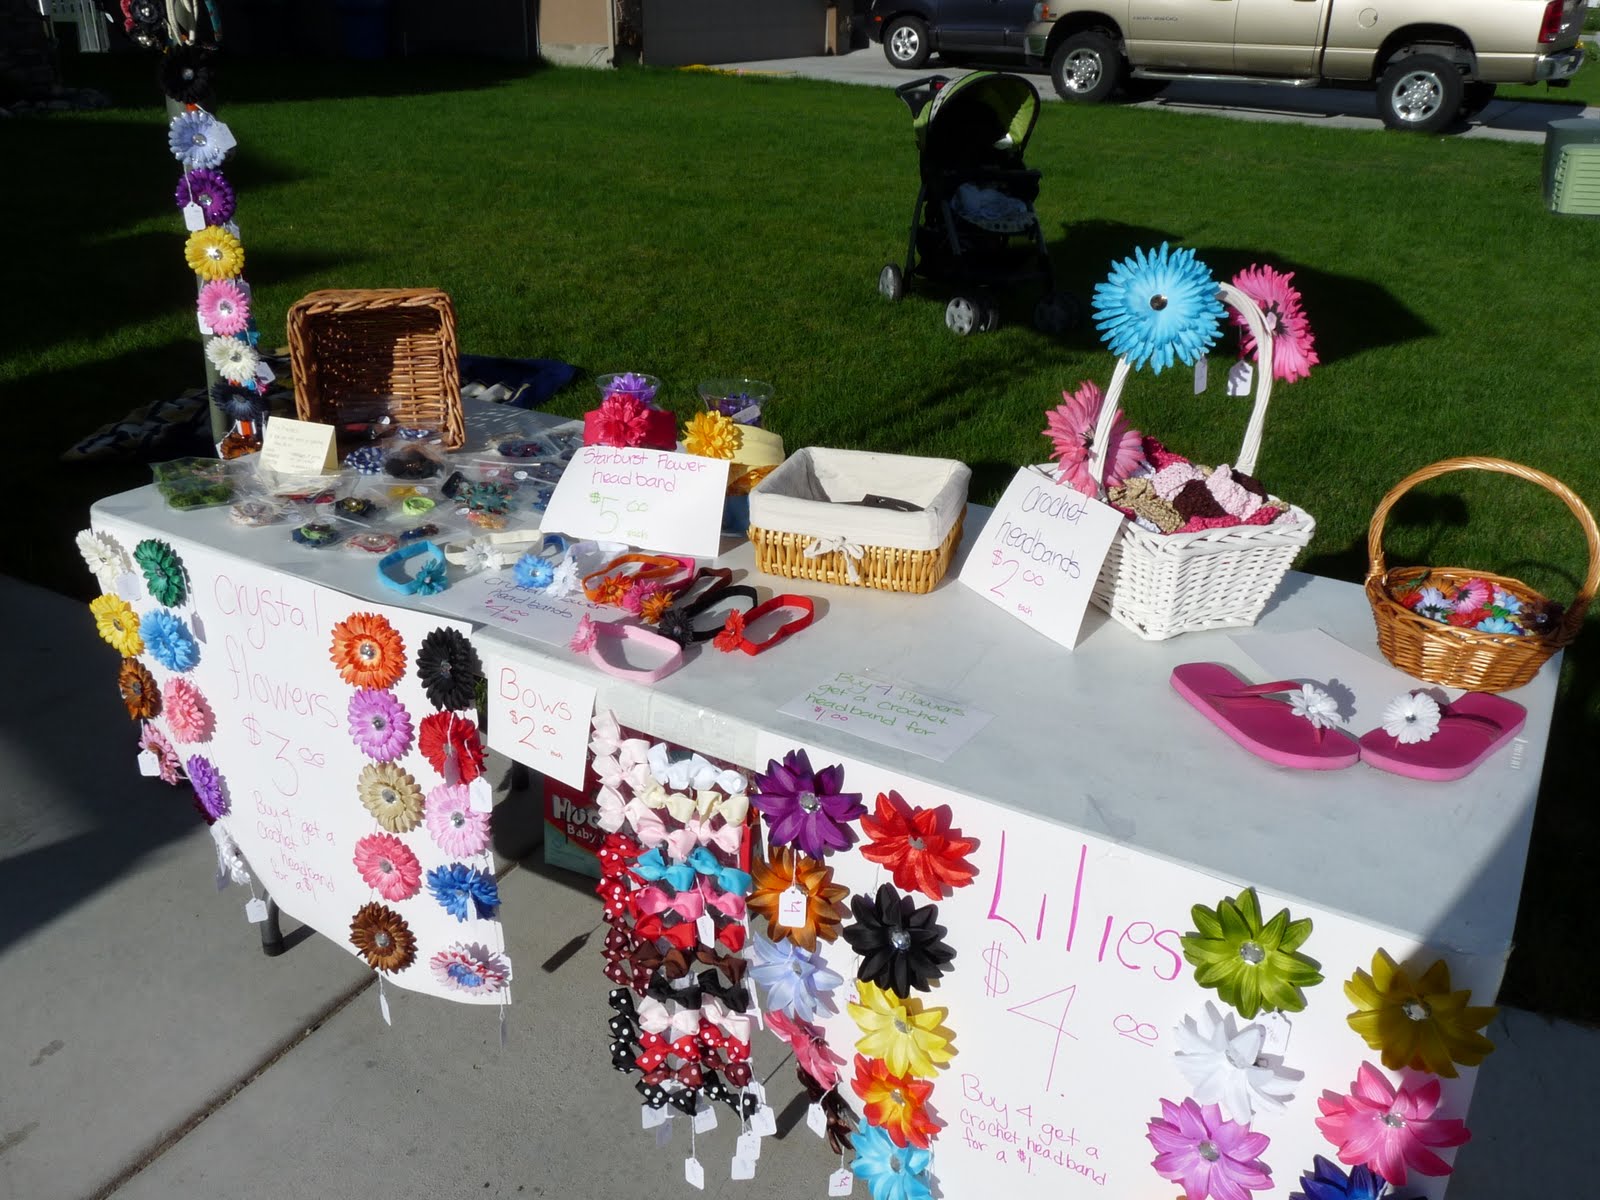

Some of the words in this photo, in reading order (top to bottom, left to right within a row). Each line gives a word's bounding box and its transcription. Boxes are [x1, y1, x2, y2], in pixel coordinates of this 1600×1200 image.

[583, 448, 649, 466] Starburst
[657, 453, 707, 473] Flower
[995, 515, 1081, 579] headbands
[214, 574, 320, 650] Crystal
[225, 634, 339, 728] flowers
[812, 684, 850, 697] get
[834, 672, 873, 693] Buy
[906, 720, 937, 737] for
[567, 824, 596, 843] Baby
[961, 1073, 1008, 1130] Buy
[1039, 1123, 1080, 1147] get
[1086, 1146, 1100, 1160] a
[962, 1127, 988, 1152] for
[996, 1150, 1008, 1163] a
[1027, 1136, 1107, 1186] headband
